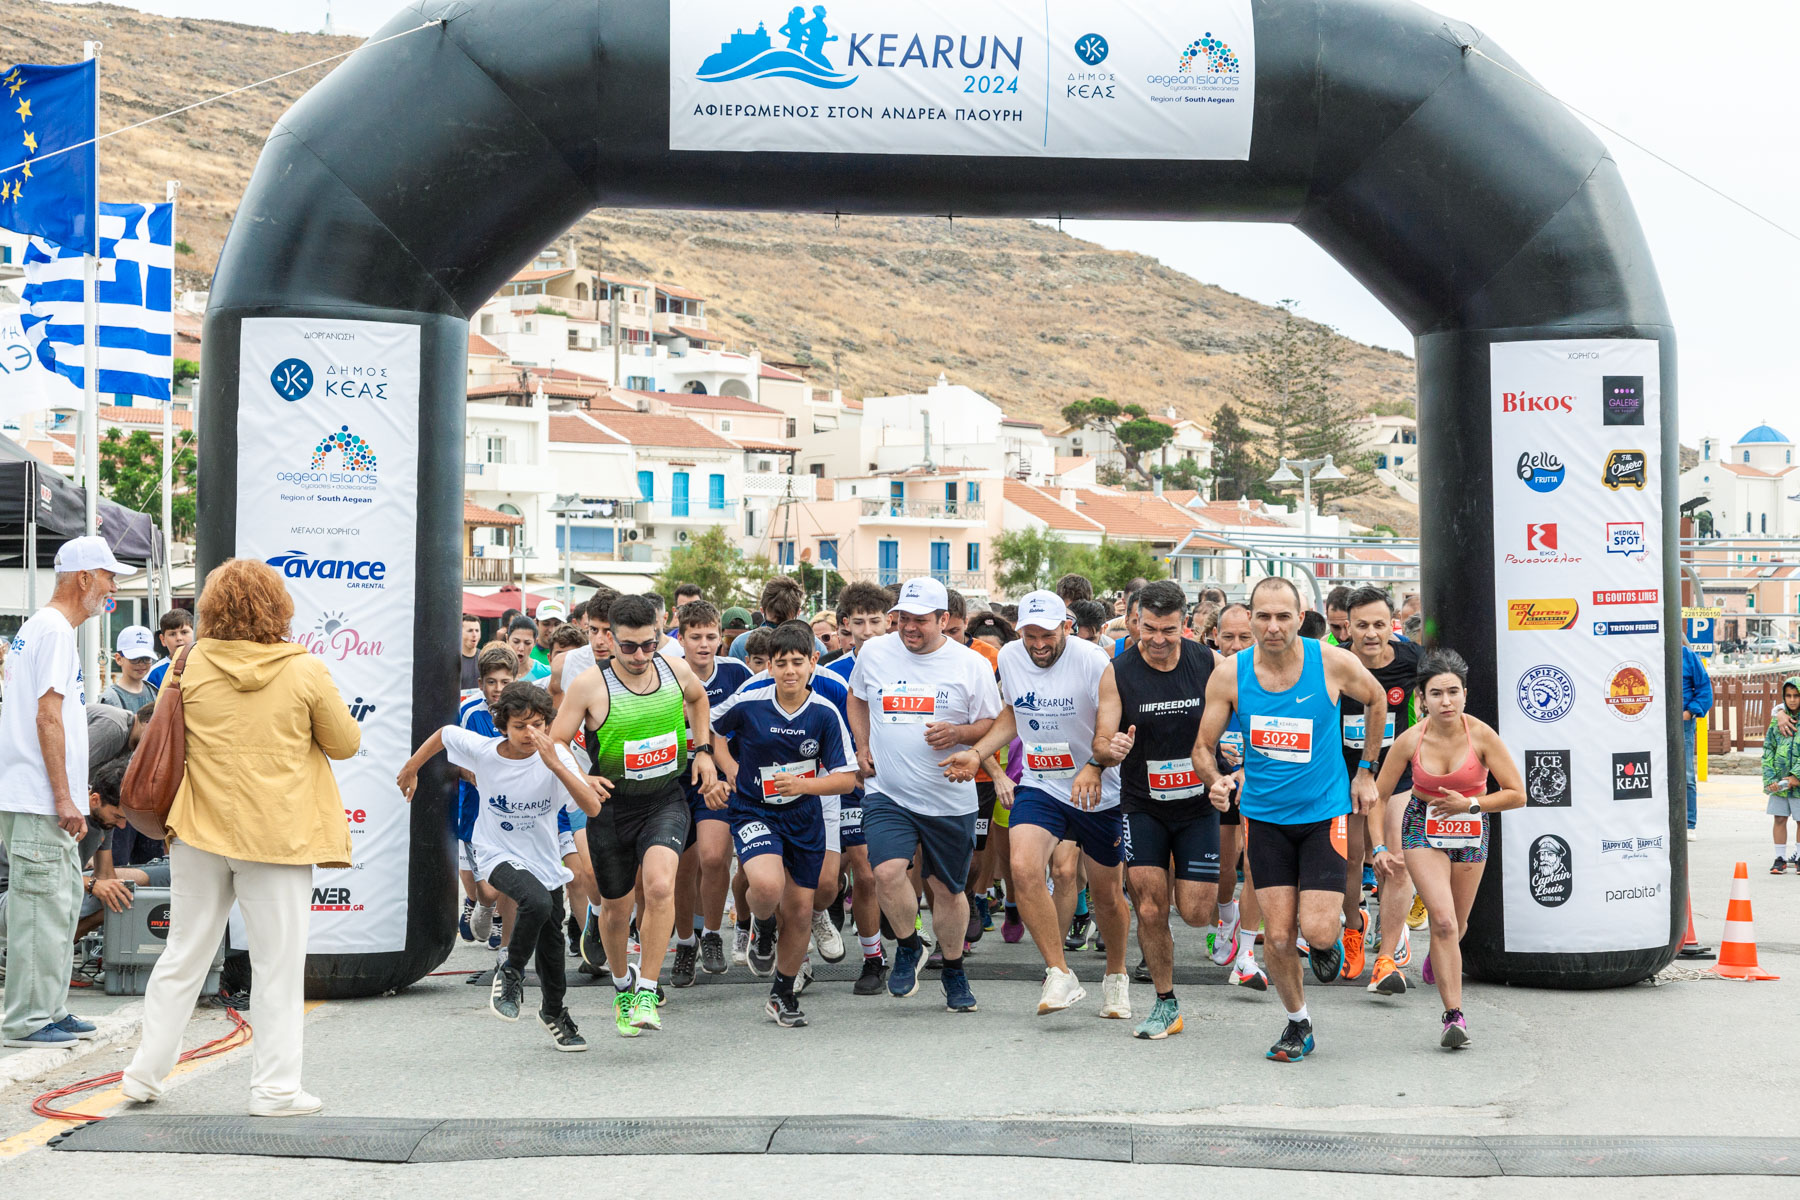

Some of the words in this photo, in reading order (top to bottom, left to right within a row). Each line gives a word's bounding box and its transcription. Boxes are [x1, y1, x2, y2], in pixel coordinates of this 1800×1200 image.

[848, 33, 1023, 71] KEARUN
[1068, 73, 1115, 81] ΔΗΜΟΣ
[1147, 75, 1194, 87] aegean
[1196, 75, 1240, 85] islands
[963, 75, 1018, 94] 2024
[1067, 84, 1116, 98] ΚΕΑΣ
[1150, 96, 1174, 104] Region
[1207, 96, 1235, 104] Aegean
[693, 103, 820, 118] ΑΦΙΕΡΩΜΕΝΟΣ
[827, 106, 873, 119] ΣΤΟΝ
[881, 106, 947, 120] ΑΝΔΡΕΑ
[955, 108, 1023, 122] ΠΑΟΥΡΗ
[304, 332, 355, 340] ΔΙΟΡΓΑΝΩΣΗ
[1567, 352, 1600, 360] ΧΟΡΗΓΟΙ
[326, 365, 387, 378] ΔΗΜΟΣ
[326, 380, 387, 400] ΚΕΑΣ
[1502, 391, 1573, 413] Βίκος
[1609, 399, 1640, 407] GALERIE
[1517, 452, 1560, 481] Bella
[1611, 460, 1643, 475] Orsero
[276, 472, 328, 485] aegean
[330, 472, 377, 484] islands
[1535, 476, 1558, 484] FRUTTA
[280, 494, 305, 502] Region
[342, 496, 372, 504] Aegean
[290, 527, 325, 535] ΜΕΓΑΛΟΙ
[327, 528, 360, 536] ΧΟΡΗΓΟΙ
[1614, 536, 1640, 545] SPOT
[284, 559, 386, 580] avance
[1605, 591, 1636, 603] GOUTOS
[1638, 591, 1657, 601] LINES
[1692, 618, 1709, 638] P
[331, 629, 385, 661] Pan
[1529, 670, 1570, 698] ΑΡΙΣΤΑΙΟΣ
[891, 697, 925, 709] 5117
[1037, 697, 1074, 707] KEARUN
[1151, 698, 1200, 712] FREEDOM
[1540, 706, 1564, 718] 2007
[770, 727, 806, 735] GIVOVA
[1262, 732, 1299, 746] 5029
[636, 749, 668, 766] 5065
[1034, 756, 1063, 766] 5013
[1533, 755, 1562, 768] ICE
[1159, 773, 1191, 786] 5131
[1616, 776, 1649, 790] ΚΕΑΣ
[511, 796, 552, 810] KEARUN
[840, 810, 863, 821] 5142
[741, 823, 767, 839] 5132
[842, 827, 862, 835] GIVO
[976, 821, 987, 830] 55
[1436, 822, 1471, 833] 5028
[741, 840, 772, 854] GIVOVA
[1602, 842, 1621, 851] HAPPY
[1621, 841, 1633, 849] DOG
[1637, 840, 1653, 849] HAPPY
[1653, 838, 1662, 847] CAT
[1531, 871, 1572, 888] Captain
[1534, 883, 1564, 897] Louis
[1605, 885, 1656, 902] parabita
